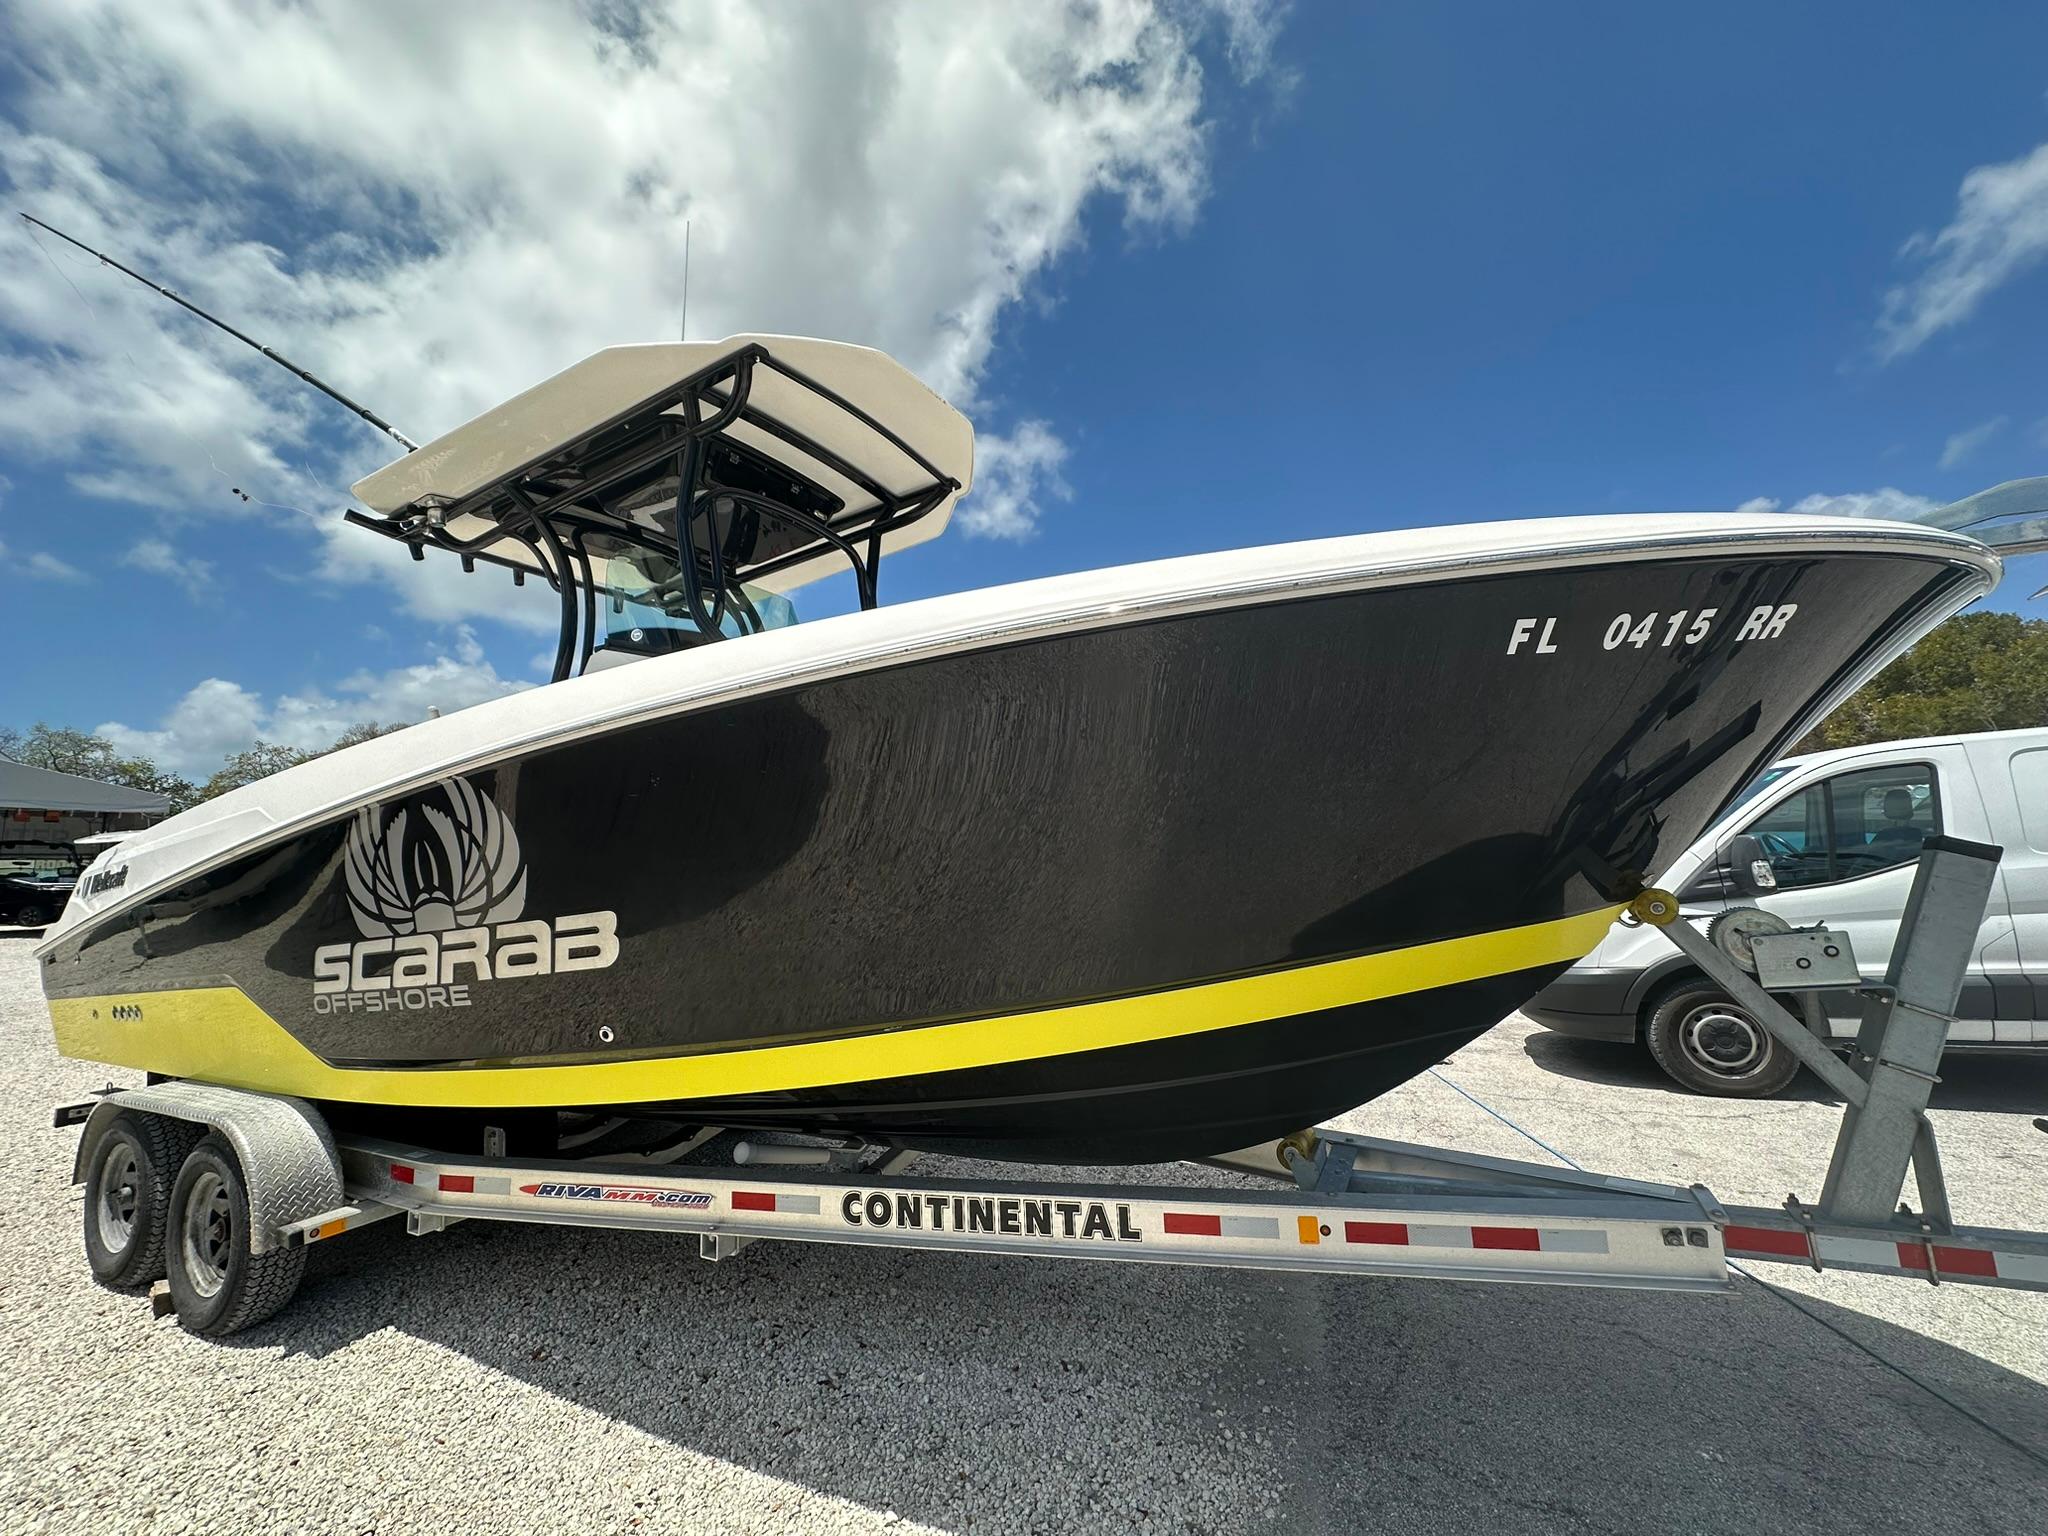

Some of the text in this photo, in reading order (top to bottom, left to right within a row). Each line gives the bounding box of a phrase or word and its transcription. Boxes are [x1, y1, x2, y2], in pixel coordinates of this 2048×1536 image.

[1506, 603, 1798, 655] FL 0415 RR
[313, 984, 472, 1014] OFFSHORE
[840, 1190, 1143, 1242] CONTINENTAL
